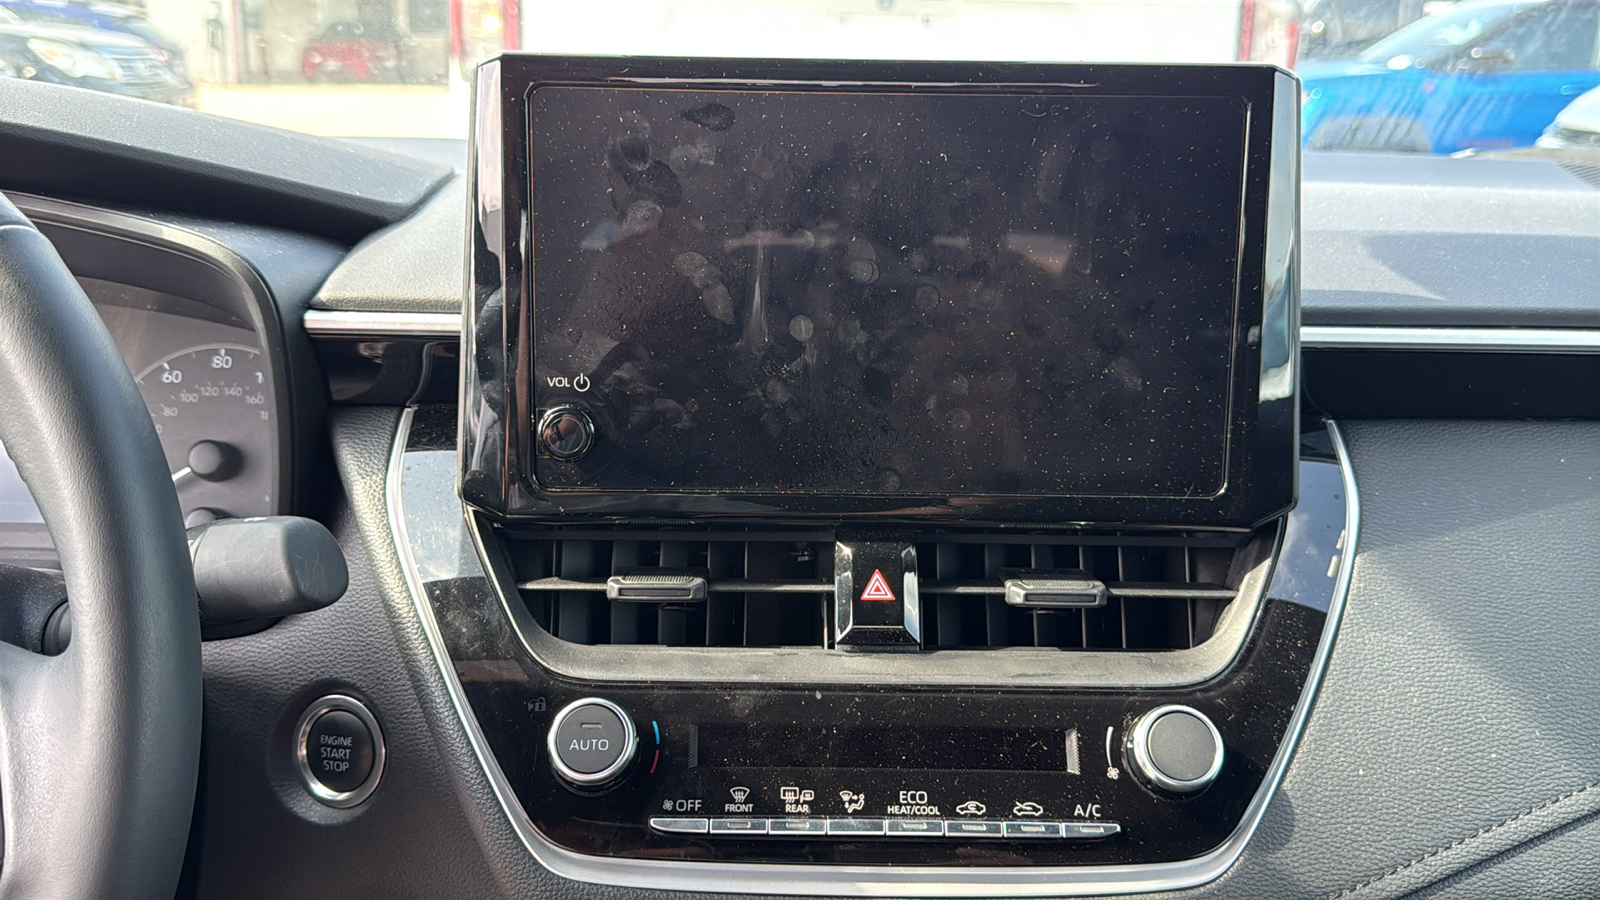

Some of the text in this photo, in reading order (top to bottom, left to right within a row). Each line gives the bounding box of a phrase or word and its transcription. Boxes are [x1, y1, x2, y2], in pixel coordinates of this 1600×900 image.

[210, 355, 233, 369] 80
[162, 370, 183, 384] 60
[547, 376, 571, 388] VOL
[200, 386, 220, 396] 120
[224, 386, 243, 397] 140
[180, 392, 199, 403] 100
[245, 394, 265, 405] 160
[320, 734, 353, 747] ENGINE
[569, 739, 609, 751] AUTO
[320, 746, 351, 760] START
[323, 759, 350, 772] STOP
[899, 791, 928, 804] ECO
[675, 799, 702, 812] OFF
[724, 803, 754, 813] FRONT
[785, 803, 810, 813] REAR
[887, 804, 941, 815] HEAT/COOL
[1073, 803, 1102, 818] A/C
